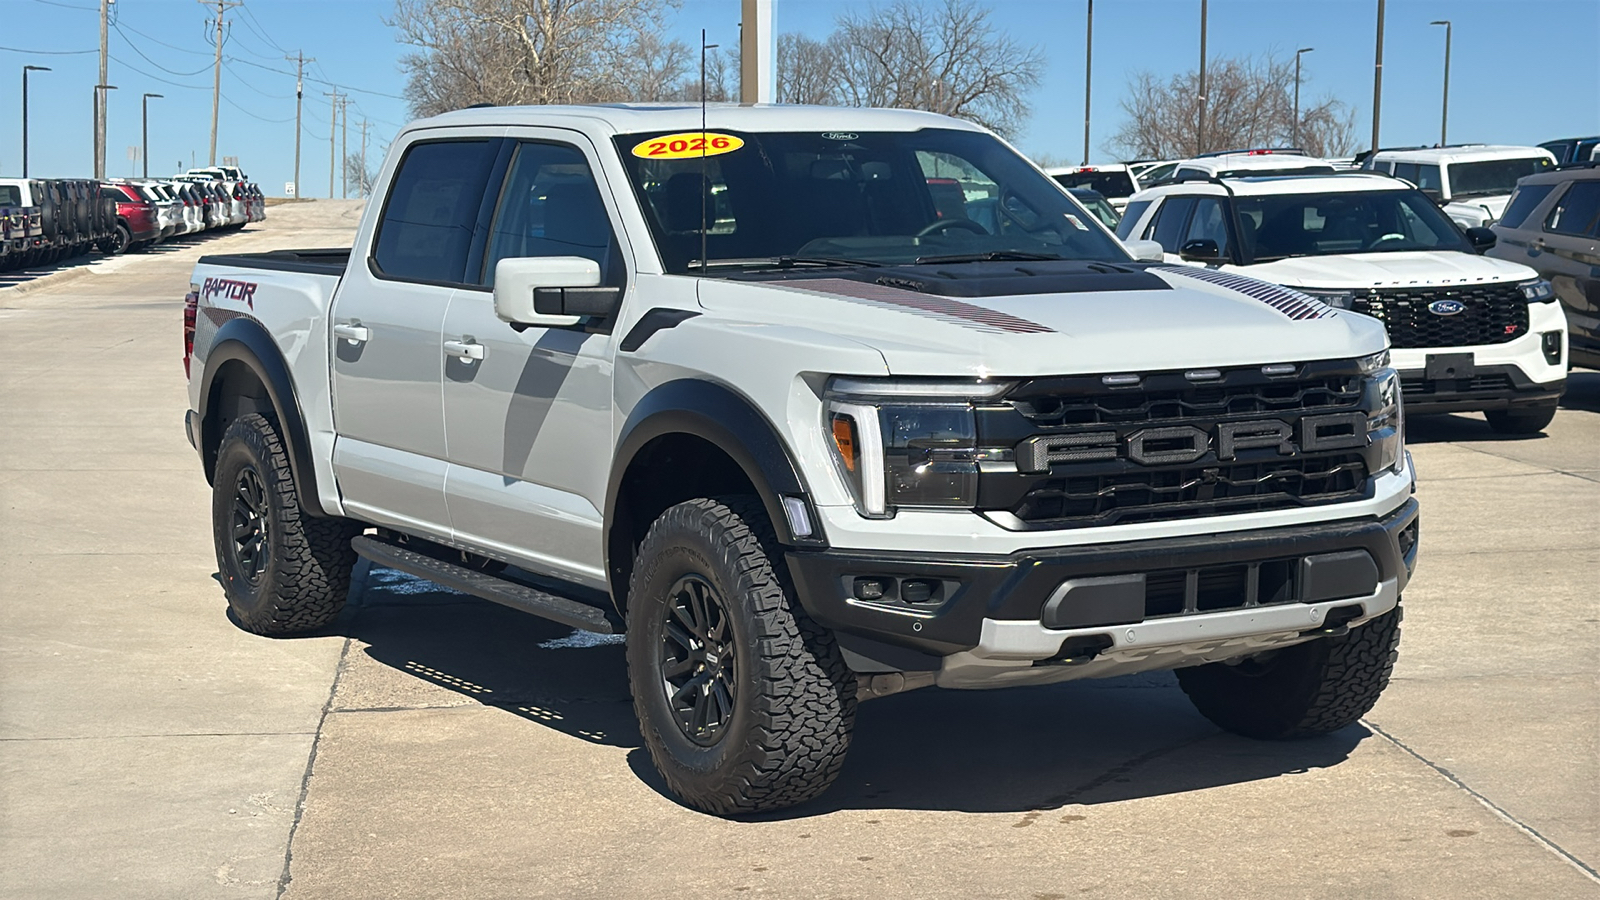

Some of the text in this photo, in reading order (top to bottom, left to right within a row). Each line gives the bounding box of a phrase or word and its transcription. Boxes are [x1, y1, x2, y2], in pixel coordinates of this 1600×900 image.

[648, 137, 730, 155] 2026
[1374, 276, 1499, 285] EXPLORER
[202, 277, 258, 311] RAPTOR
[1504, 325, 1518, 333] ST
[1016, 411, 1368, 476] FORD
